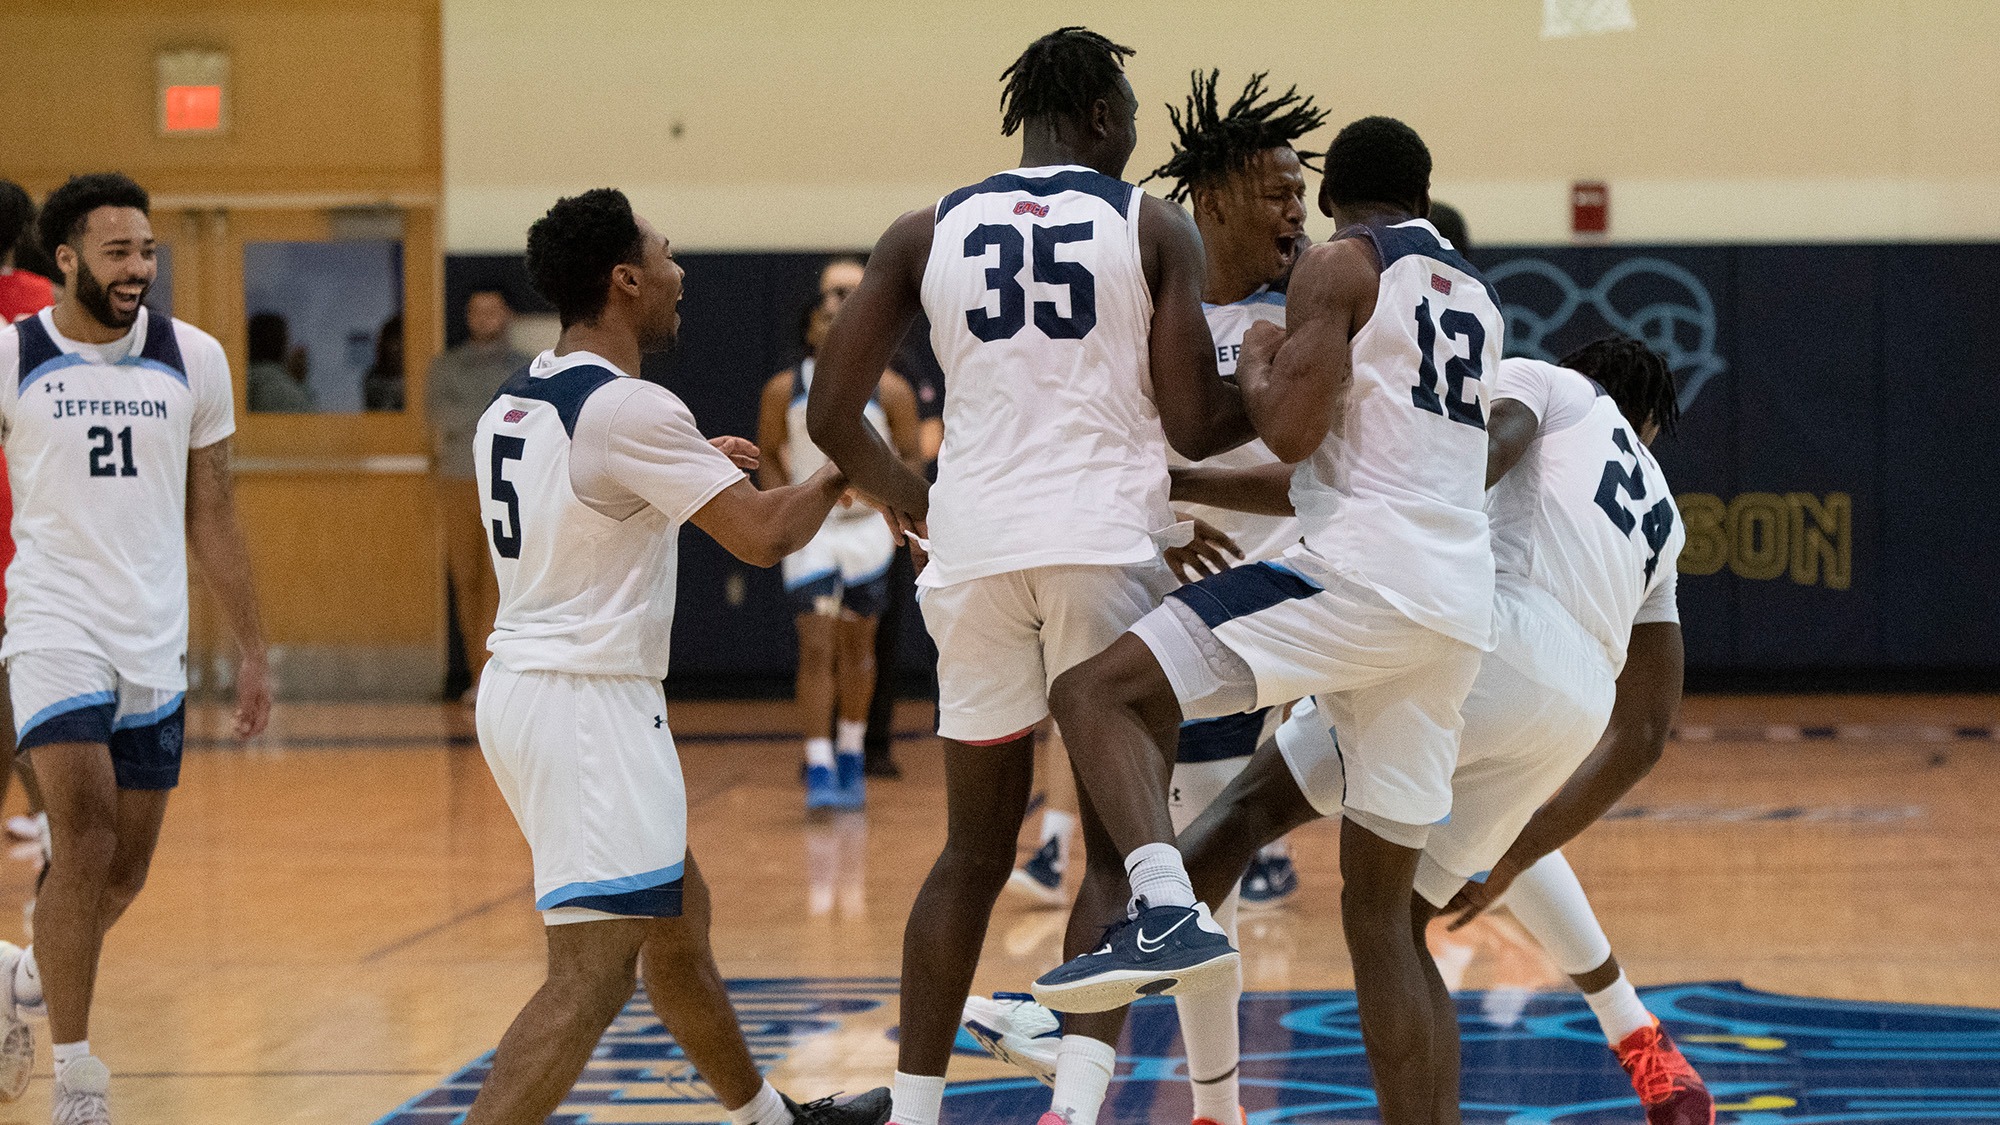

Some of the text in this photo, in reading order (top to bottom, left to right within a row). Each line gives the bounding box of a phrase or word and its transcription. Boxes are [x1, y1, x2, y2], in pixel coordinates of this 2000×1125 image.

[963, 220, 1097, 343] 35
[53, 400, 167, 419] JEFFERSON
[1411, 295, 1487, 432] 12
[87, 426, 138, 477] 21
[491, 433, 527, 560] 5
[1593, 428, 1674, 594] 24
